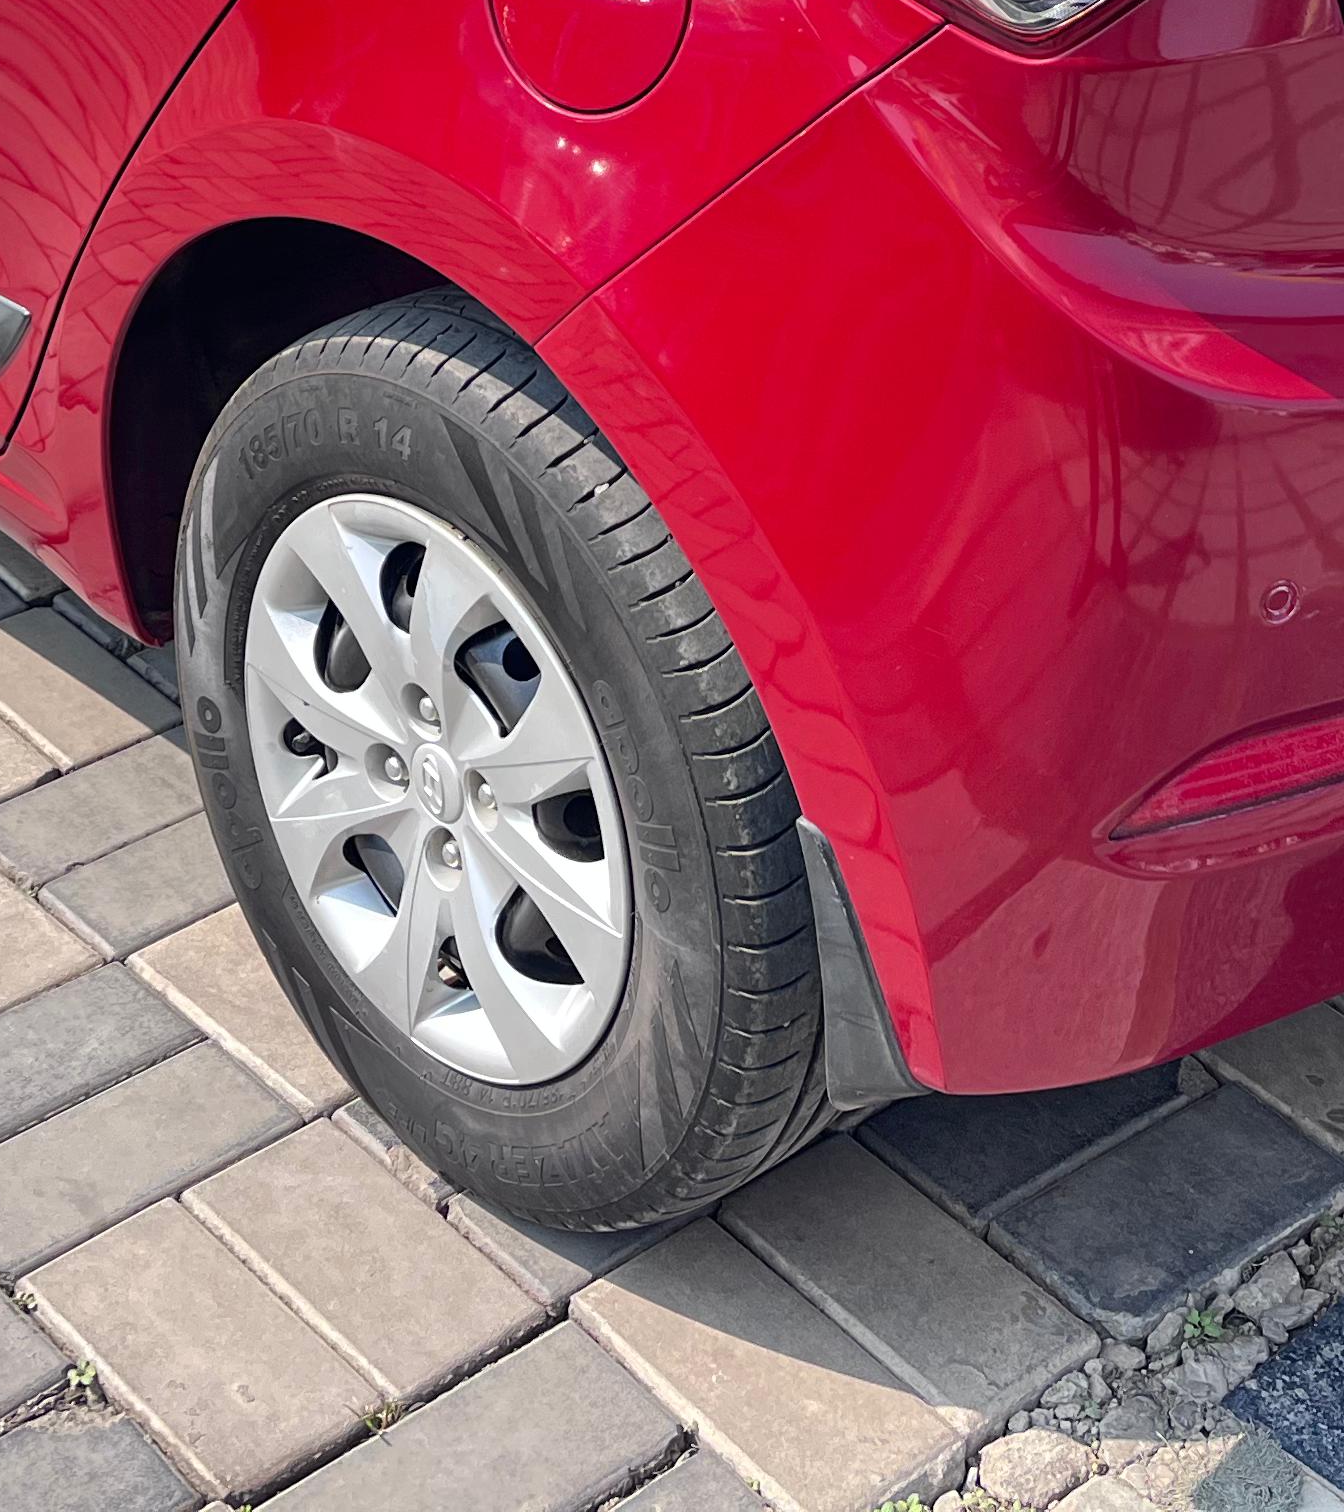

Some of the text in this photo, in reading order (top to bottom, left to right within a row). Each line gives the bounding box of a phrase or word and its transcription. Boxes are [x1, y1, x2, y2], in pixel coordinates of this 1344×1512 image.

[237, 406, 413, 480] 185/70 R 14
[192, 694, 265, 891] apollo
[592, 679, 682, 915] apollo
